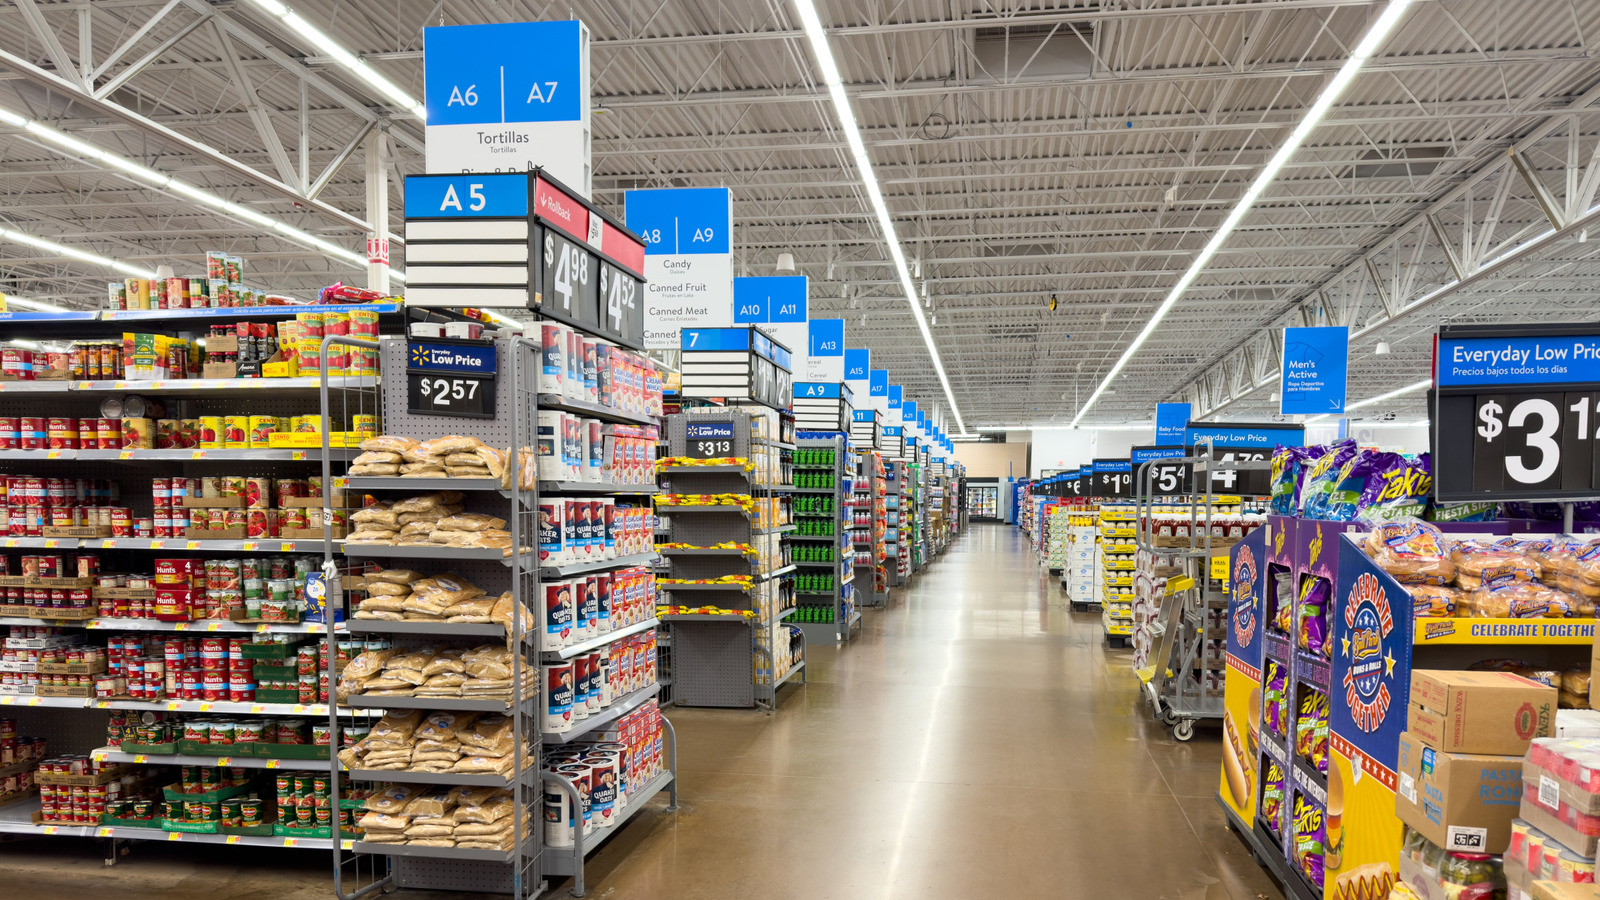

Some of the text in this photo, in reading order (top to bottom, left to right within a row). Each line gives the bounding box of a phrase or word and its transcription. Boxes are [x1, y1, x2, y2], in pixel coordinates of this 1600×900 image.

[447, 82, 558, 107] A6 A7
[477, 131, 529, 144] Tortillas
[490, 146, 517, 154] Tortillas
[547, 196, 571, 222] Rollback
[642, 228, 714, 244] A8 A9
[663, 259, 692, 272] Candy
[649, 282, 707, 292] Canned Fruit
[649, 306, 708, 316] Canned Meat
[740, 304, 797, 315] A10 A11
[643, 330, 677, 339] Canned
[820, 341, 837, 350] A13
[431, 348, 451, 356] Everyday
[1453, 345, 1531, 366] Everyday
[1535, 344, 1568, 361] Low
[431, 353, 482, 367] Low Price
[1289, 359, 1316, 369] Men's
[1288, 370, 1317, 379] Active
[1452, 365, 1568, 377] Precios bajos todos los días
[1158, 426, 1171, 434] Baby
[1193, 433, 1268, 442] Everyday Low Price
[1137, 452, 1162, 460] Everyday
[1370, 507, 1403, 518] FIESTA
[1435, 507, 1470, 521] FIESTA
[184, 561, 191, 570] 4
[184, 592, 191, 601] 4
[1345, 572, 1394, 639] CELEBRATE
[1471, 624, 1595, 637] CELEBRATE TOGETHE
[1353, 664, 1365, 675] BUNS
[1369, 661, 1382, 671] ROLLS
[1343, 666, 1392, 733] TOGETHER
[1454, 714, 1462, 748] DRESSING
[1424, 782, 1443, 803] PASTA
[1480, 785, 1521, 798] RON
